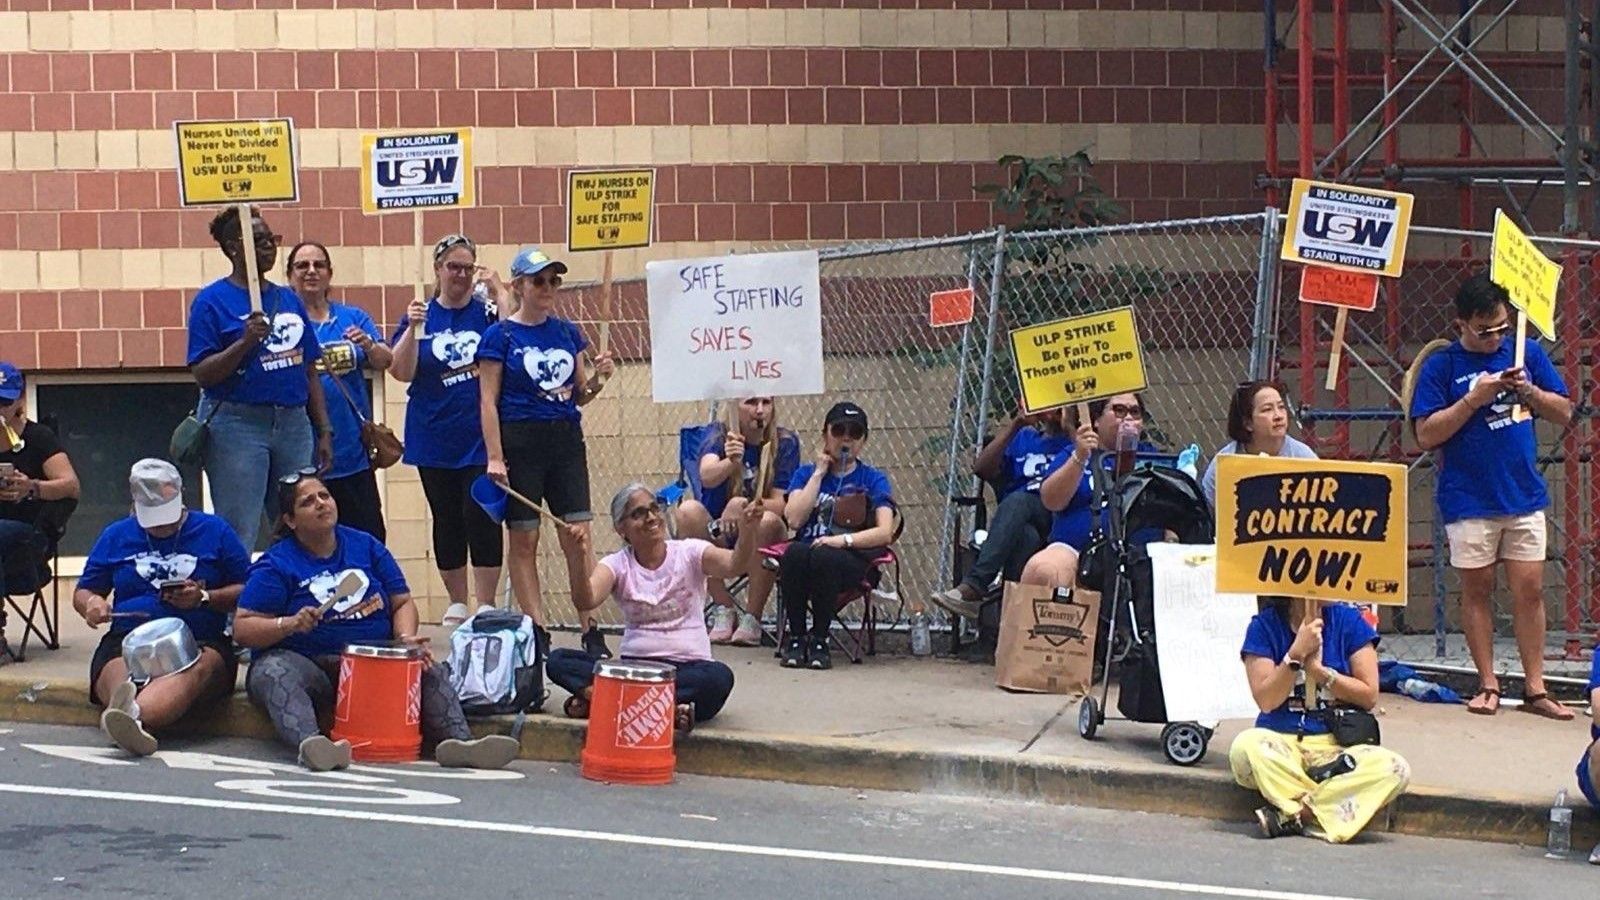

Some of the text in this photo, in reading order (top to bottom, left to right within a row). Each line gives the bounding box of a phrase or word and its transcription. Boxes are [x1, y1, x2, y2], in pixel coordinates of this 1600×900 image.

[184, 127, 283, 139] Nurses United Will
[383, 135, 451, 147] IN SOLIDARITY
[187, 138, 279, 150] Never be Divided
[202, 153, 267, 164] In Solidarity
[193, 164, 278, 176] USW ULP Strike
[377, 156, 459, 187] USW
[576, 176, 649, 189] RWJ NURSES ON
[381, 195, 454, 208] STAND WITH US
[585, 189, 638, 201] ULP STRIKE
[1316, 188, 1389, 207] IN SOLIDARITY
[602, 202, 620, 212] FOR
[576, 212, 643, 225] SAFE STAFFING
[1303, 209, 1394, 248] USW
[1303, 248, 1381, 269] STAND WITH US
[679, 264, 726, 293] SAFE
[713, 285, 803, 315] STAFFING
[689, 326, 753, 354] SAVES
[1033, 321, 1117, 347] ULP STRIKE
[1042, 340, 1110, 362] Be Fair To
[731, 360, 783, 381] LIVES
[1024, 351, 1133, 379] Those Who Care
[1279, 476, 1339, 504] FAIR
[1246, 507, 1379, 536] CONTRACT
[1258, 545, 1362, 592] NOW!
[1365, 580, 1399, 593] USW
